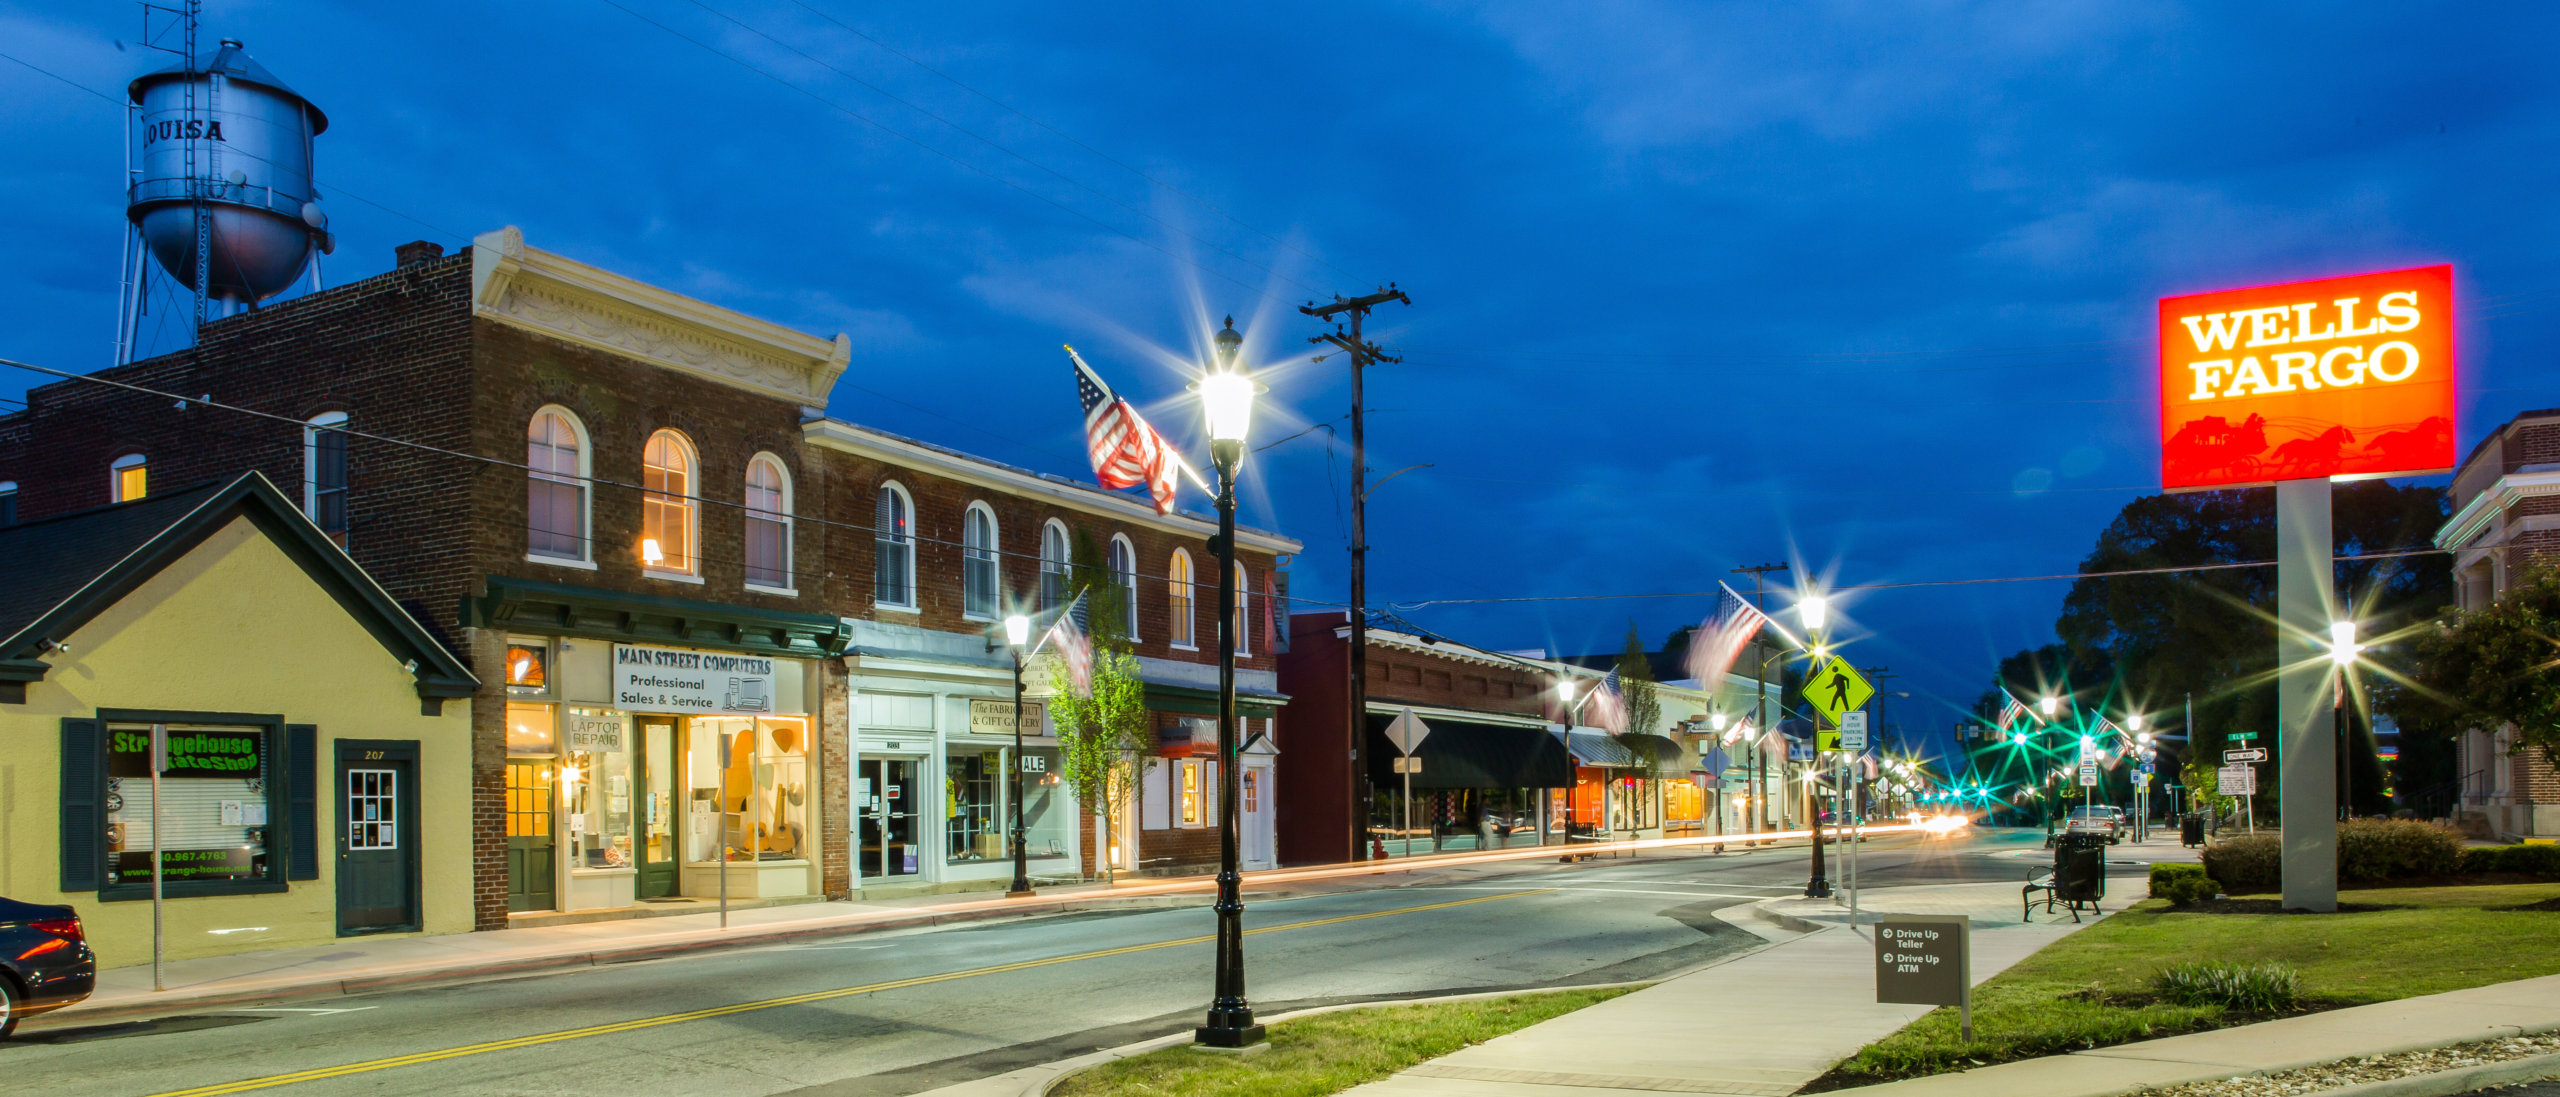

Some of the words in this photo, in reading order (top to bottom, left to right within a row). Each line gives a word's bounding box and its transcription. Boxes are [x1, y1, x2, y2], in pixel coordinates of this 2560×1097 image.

[142, 118, 226, 149] OUISA
[2180, 291, 2421, 352] WELLS
[2189, 340, 2420, 401] FARGO
[618, 647, 652, 665] MAIN
[655, 650, 701, 669] STREET
[704, 655, 771, 675] COMPUTERS
[630, 674, 705, 690] Professional
[621, 691, 654, 705] Sales
[658, 694, 667, 705] &
[672, 695, 713, 708] Service
[974, 703, 989, 713] The
[571, 721, 620, 733] LAPTOP
[972, 716, 979, 724] &
[981, 716, 1003, 726] GIFT
[114, 731, 253, 756] StrgeHouse
[573, 733, 618, 746] REPAIR
[364, 750, 384, 760] 207
[167, 753, 258, 771] kateShop
[1023, 757, 1044, 771] ALE
[123, 864, 252, 877] www.trange-house.net
[1896, 929, 1923, 938] Drive
[1924, 930, 1939, 940] Up
[1896, 940, 1924, 948] Teller
[1897, 954, 1923, 963] Drive
[1925, 954, 1940, 965] Up
[1897, 964, 1919, 973] ATM
